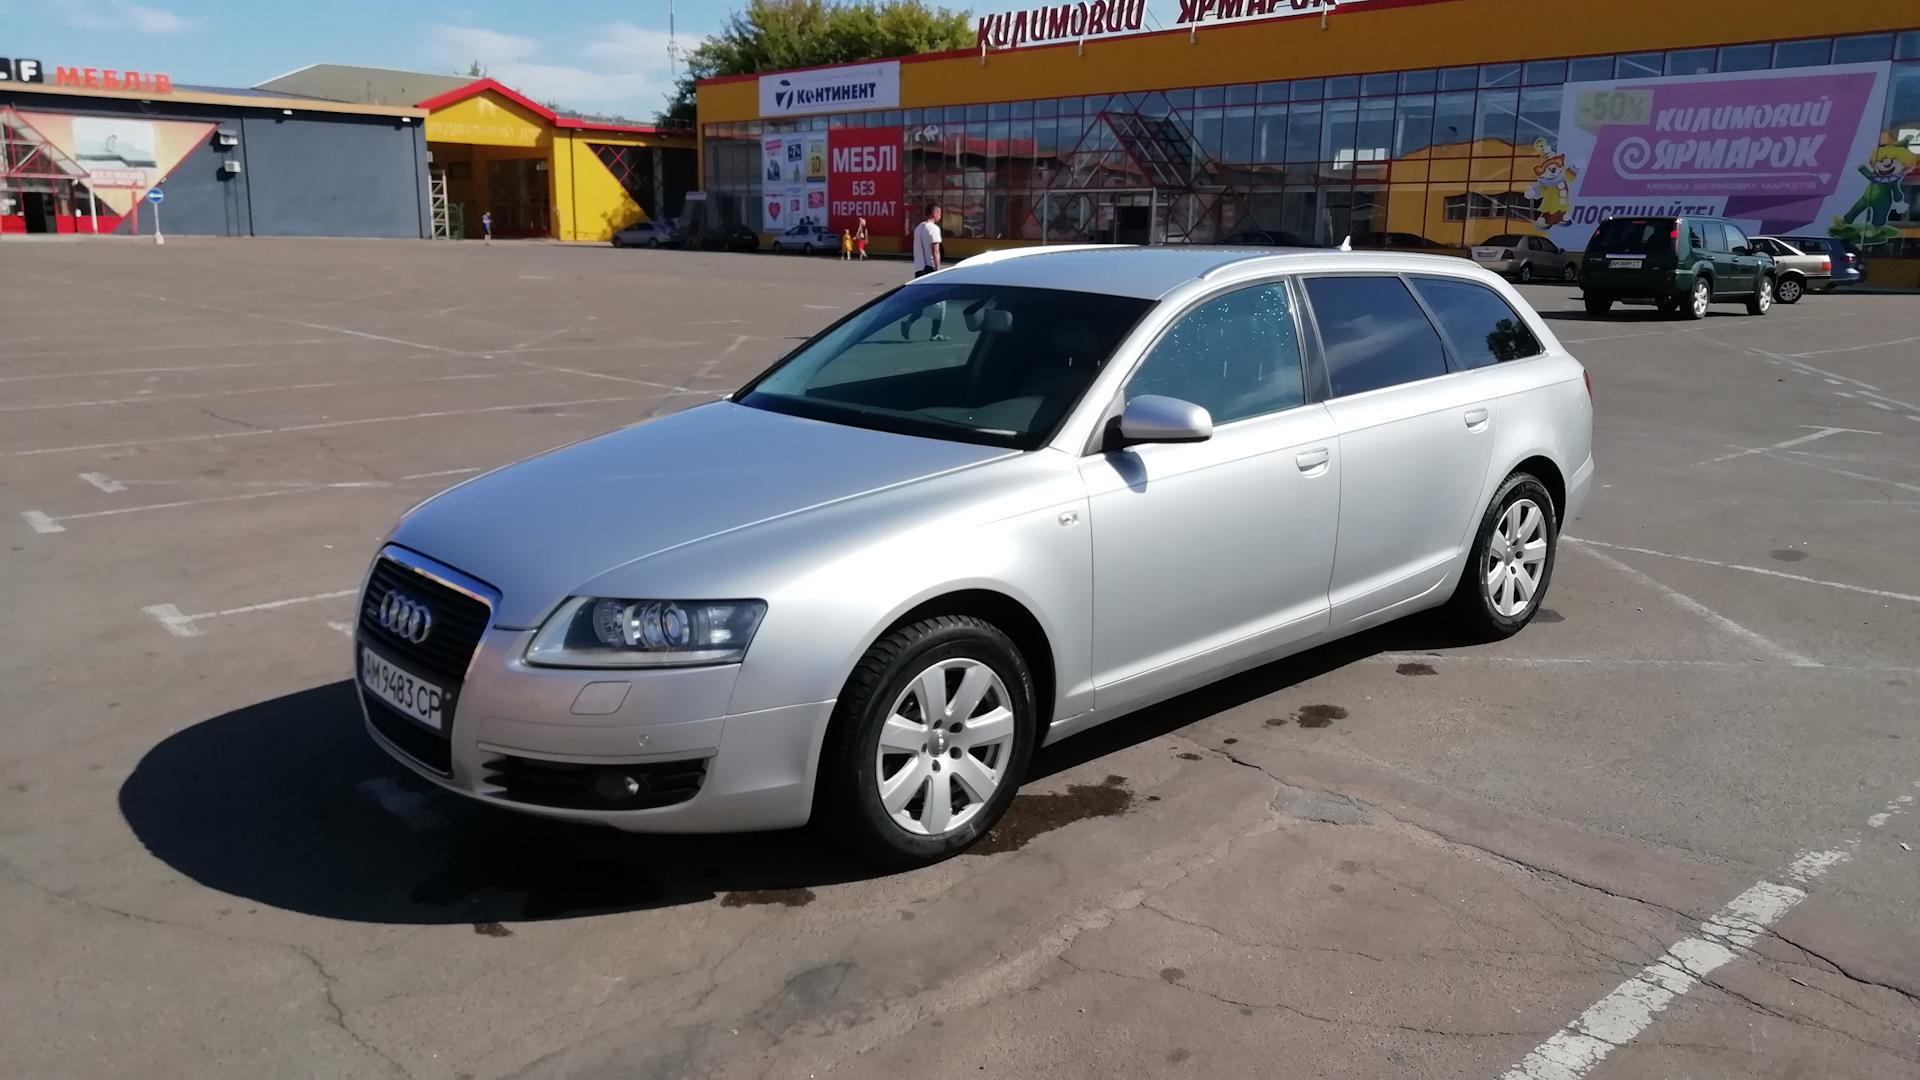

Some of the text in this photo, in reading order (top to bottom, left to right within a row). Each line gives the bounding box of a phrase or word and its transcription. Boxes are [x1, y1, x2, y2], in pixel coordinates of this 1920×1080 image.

[56, 66, 173, 94] МЕБЛІВ
[796, 82, 877, 105] КОНТИНЕНТ
[1581, 91, 1644, 121] -50%
[1655, 95, 1833, 133] КИЛИМОВИЙ
[832, 145, 897, 173] МЕБЛІ
[1650, 134, 1828, 170] ЯРМАРОК
[851, 180, 876, 196] БЕЗ
[832, 200, 897, 217] ПЕРЕПЛАТ
[364, 654, 442, 719] AM 9483 CP
